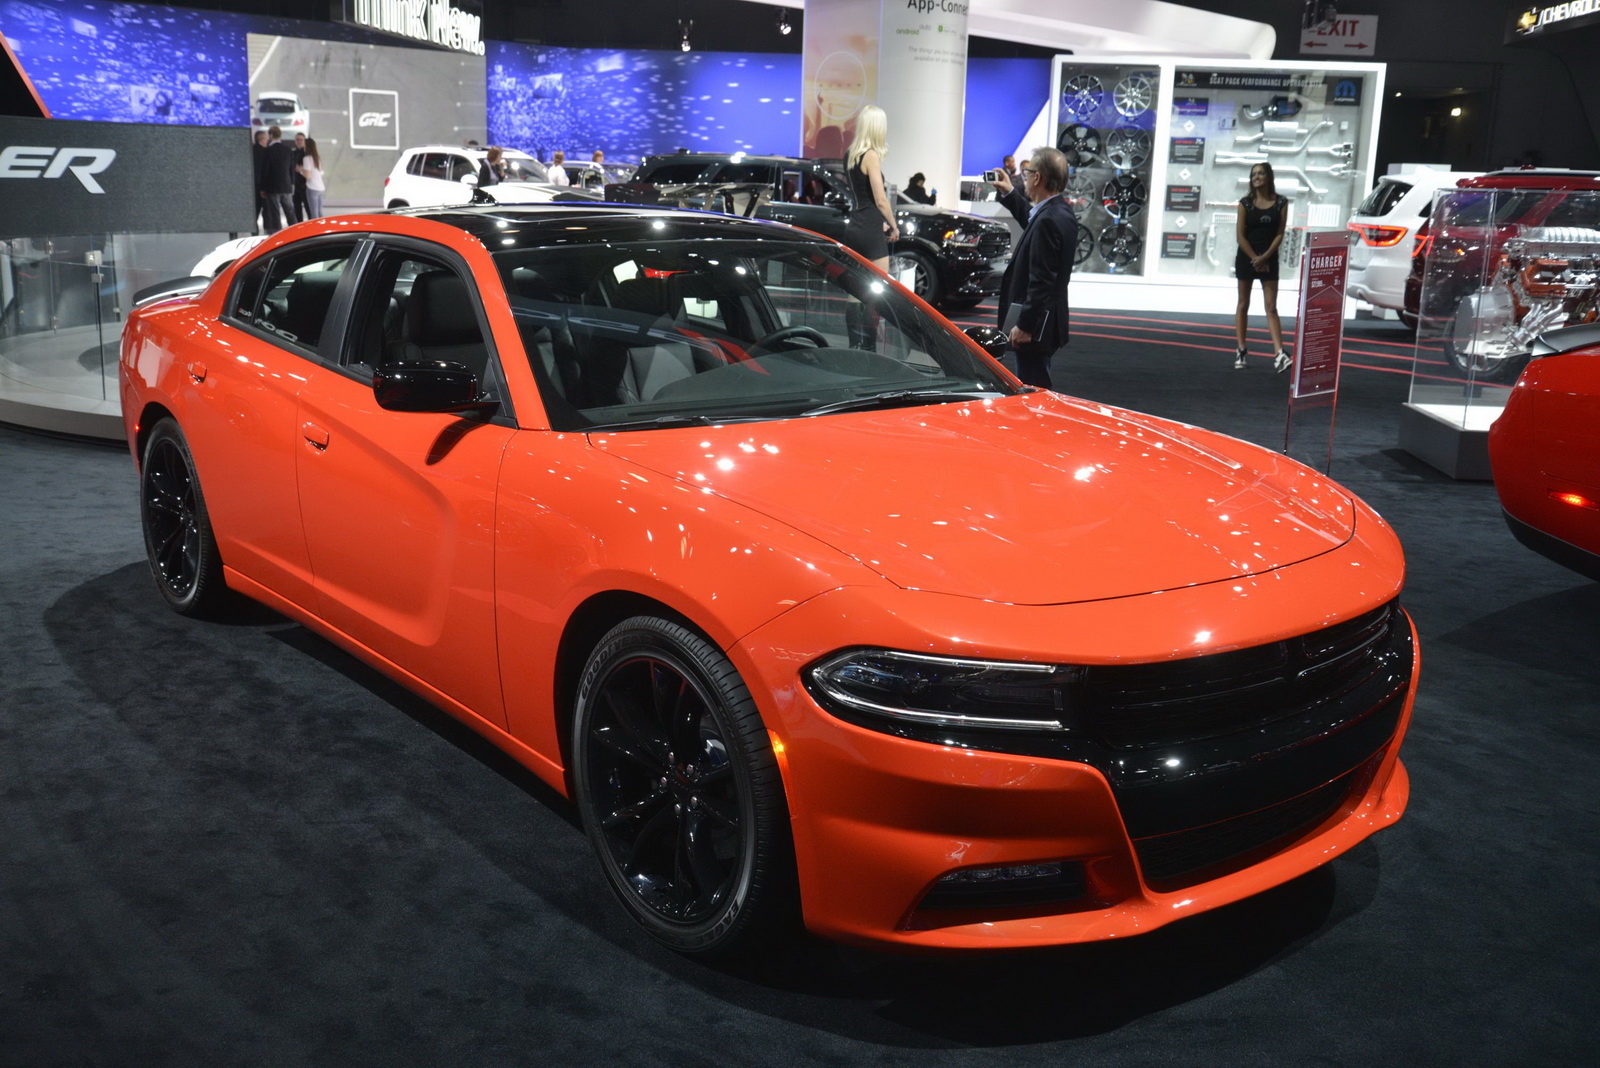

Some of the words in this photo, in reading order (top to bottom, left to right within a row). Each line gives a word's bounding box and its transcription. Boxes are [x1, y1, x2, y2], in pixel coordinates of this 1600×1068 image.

[896, 28, 920, 36] android
[1209, 76, 1224, 85] SCAT
[1224, 77, 1240, 86] PACK
[1241, 77, 1282, 87] PERFORMANCE
[1310, 255, 1343, 270] CHARGER
